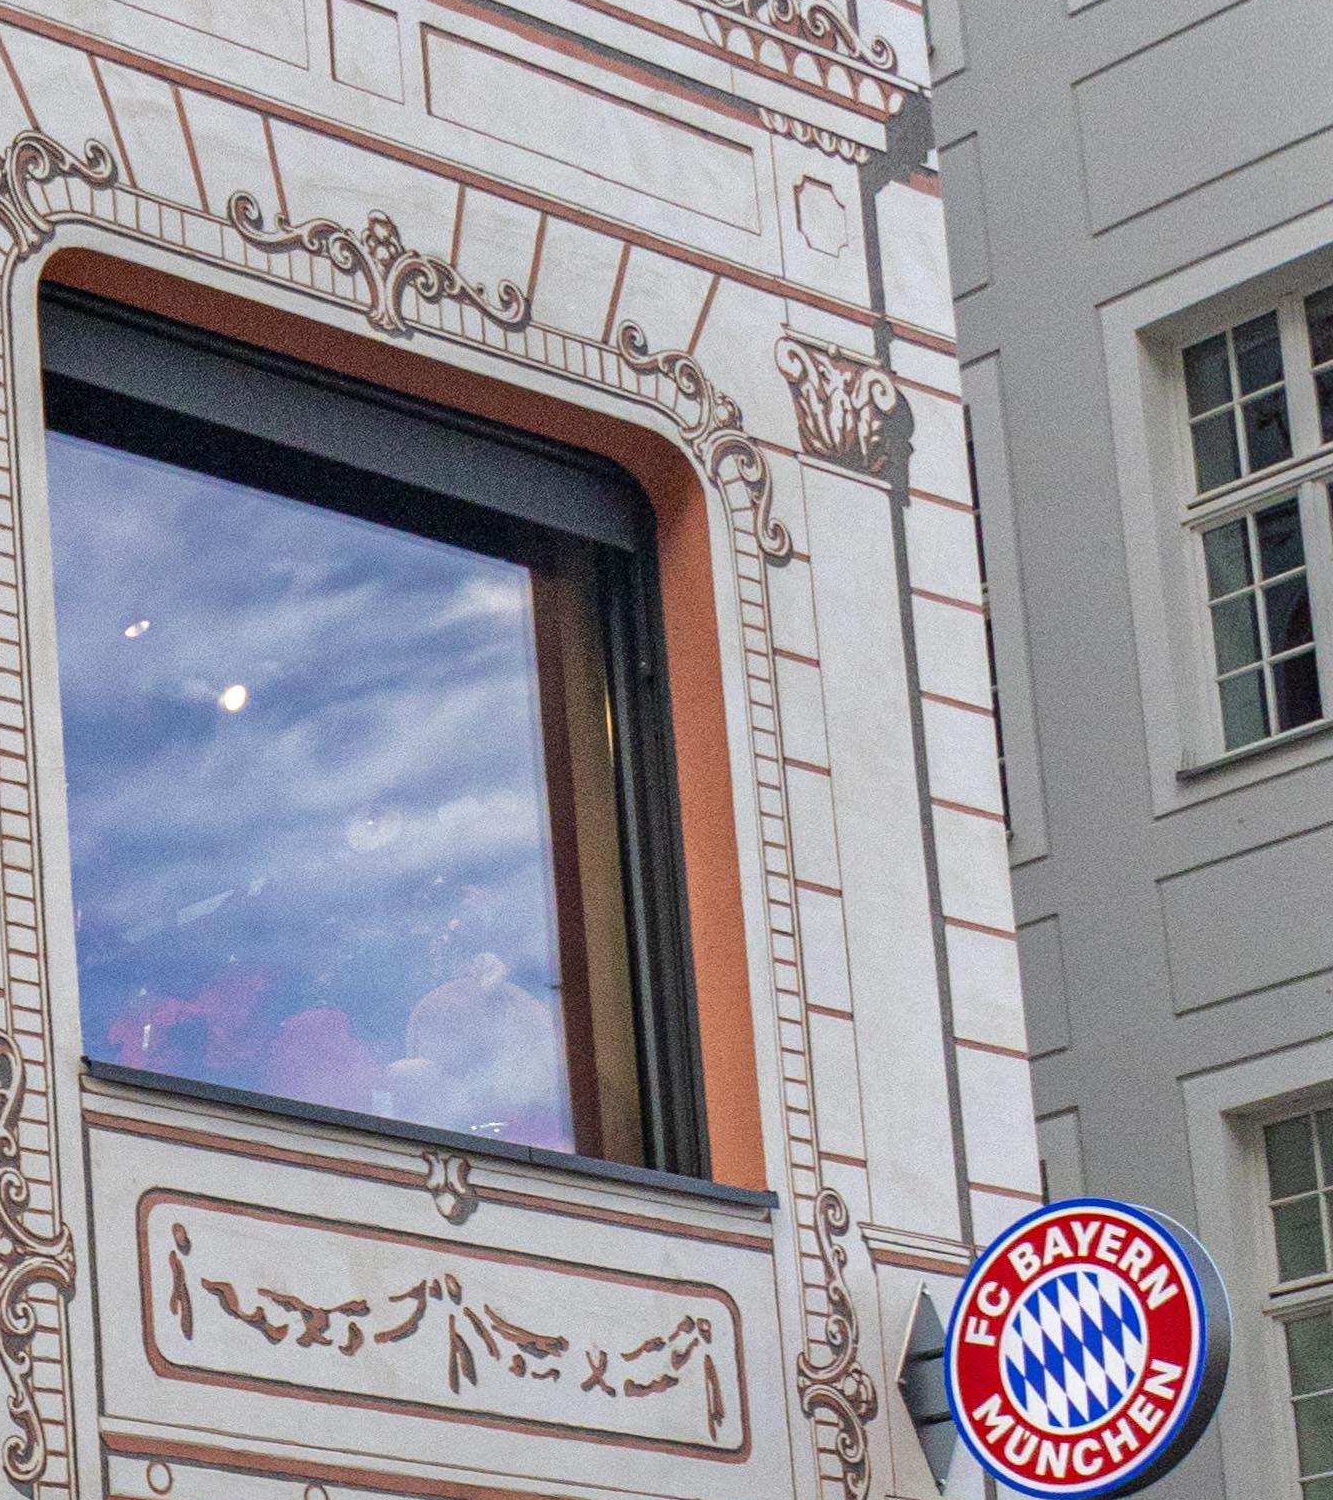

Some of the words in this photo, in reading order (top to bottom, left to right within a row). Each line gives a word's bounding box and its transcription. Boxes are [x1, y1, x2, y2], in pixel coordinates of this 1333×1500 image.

[965, 1281, 1008, 1346] FC
[1010, 1220, 1180, 1310] BAYERN
[972, 1357, 1184, 1479] MÜNCHEN
